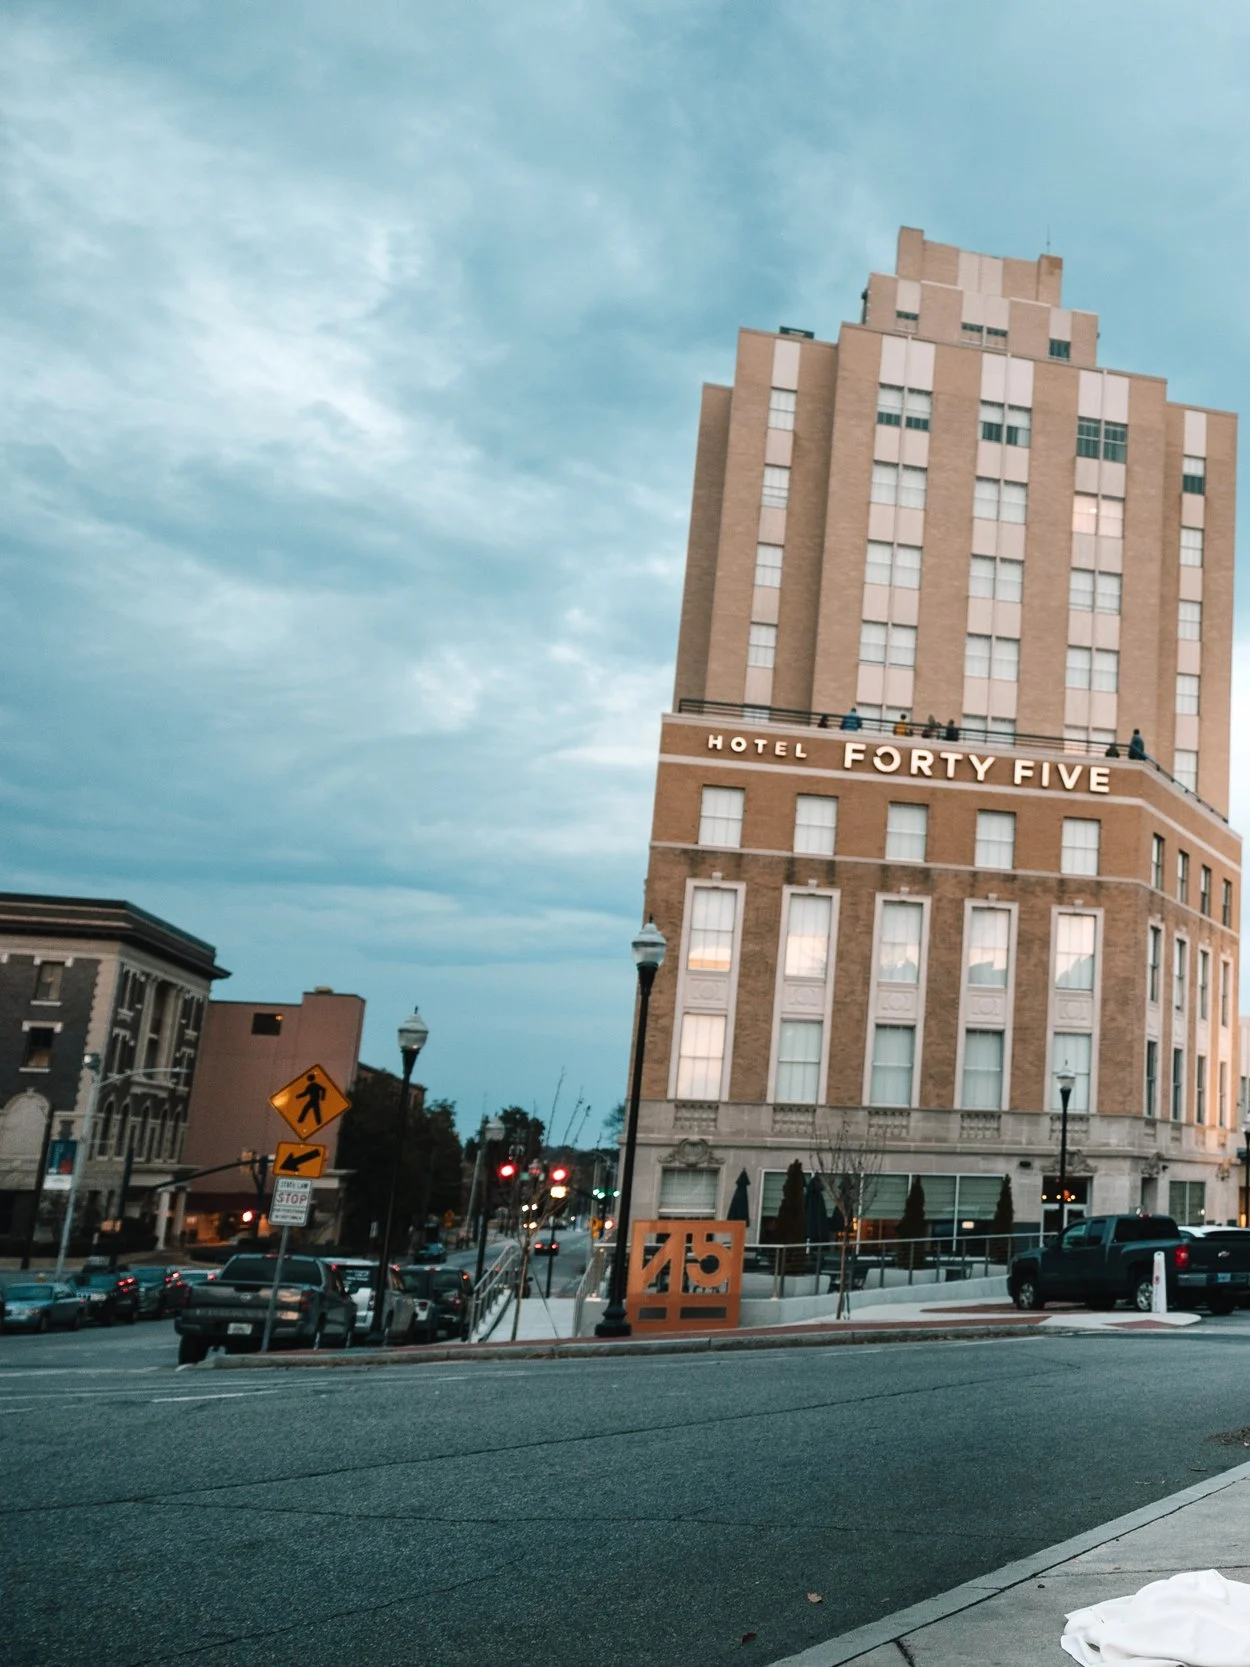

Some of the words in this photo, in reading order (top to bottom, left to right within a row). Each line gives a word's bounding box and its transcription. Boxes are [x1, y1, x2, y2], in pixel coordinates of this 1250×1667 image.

[707, 734, 808, 759] HOTEL
[843, 742, 996, 782] FORTY
[1013, 759, 1111, 793] FIVE
[276, 1192, 308, 1205] STOP
[641, 1228, 734, 1294] 45
